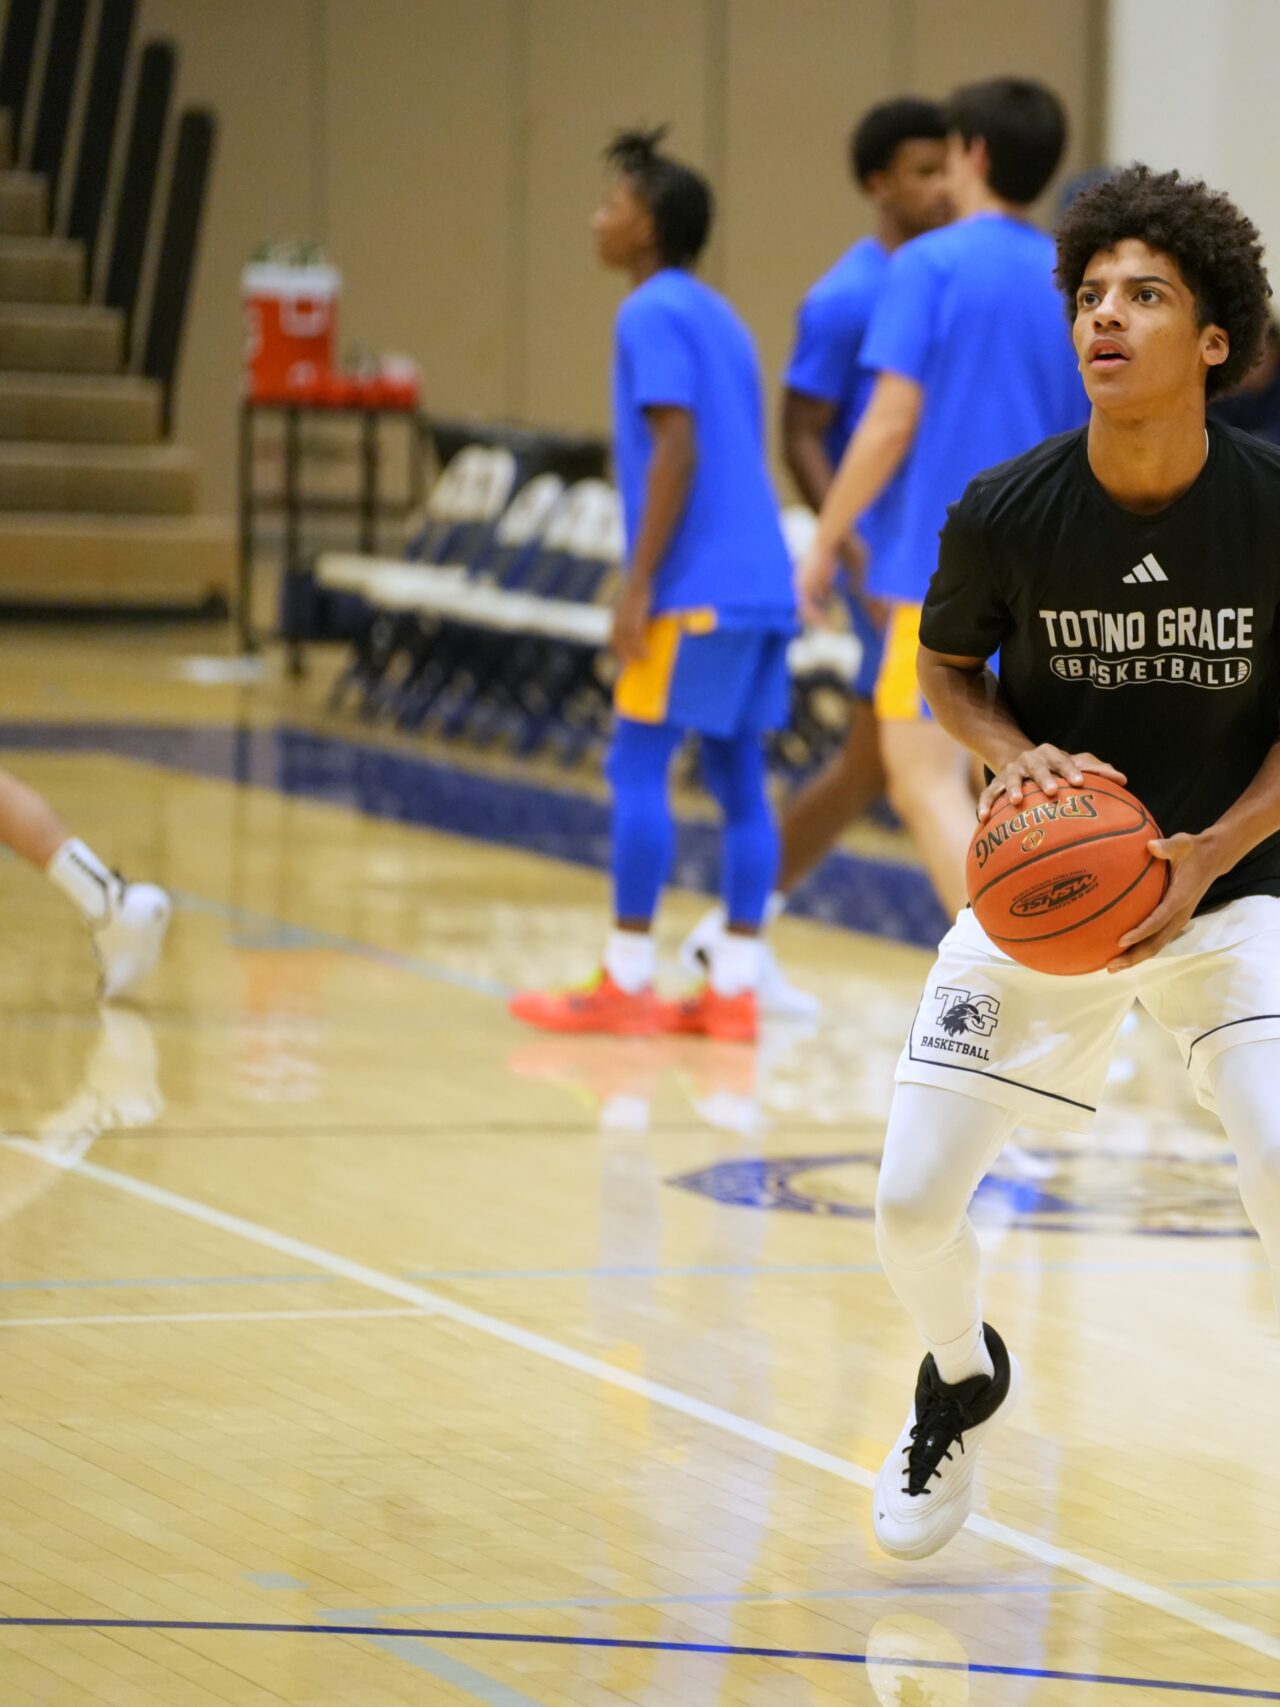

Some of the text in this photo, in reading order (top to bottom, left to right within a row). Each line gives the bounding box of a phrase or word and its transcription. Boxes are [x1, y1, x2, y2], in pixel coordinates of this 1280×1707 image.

[1157, 607, 1254, 650] GRACE
[1067, 658, 1236, 685] BASKETBALL
[975, 794, 1098, 868] SPALDING
[935, 986, 1001, 1037] TG
[920, 1036, 990, 1061] BASKETBALL
